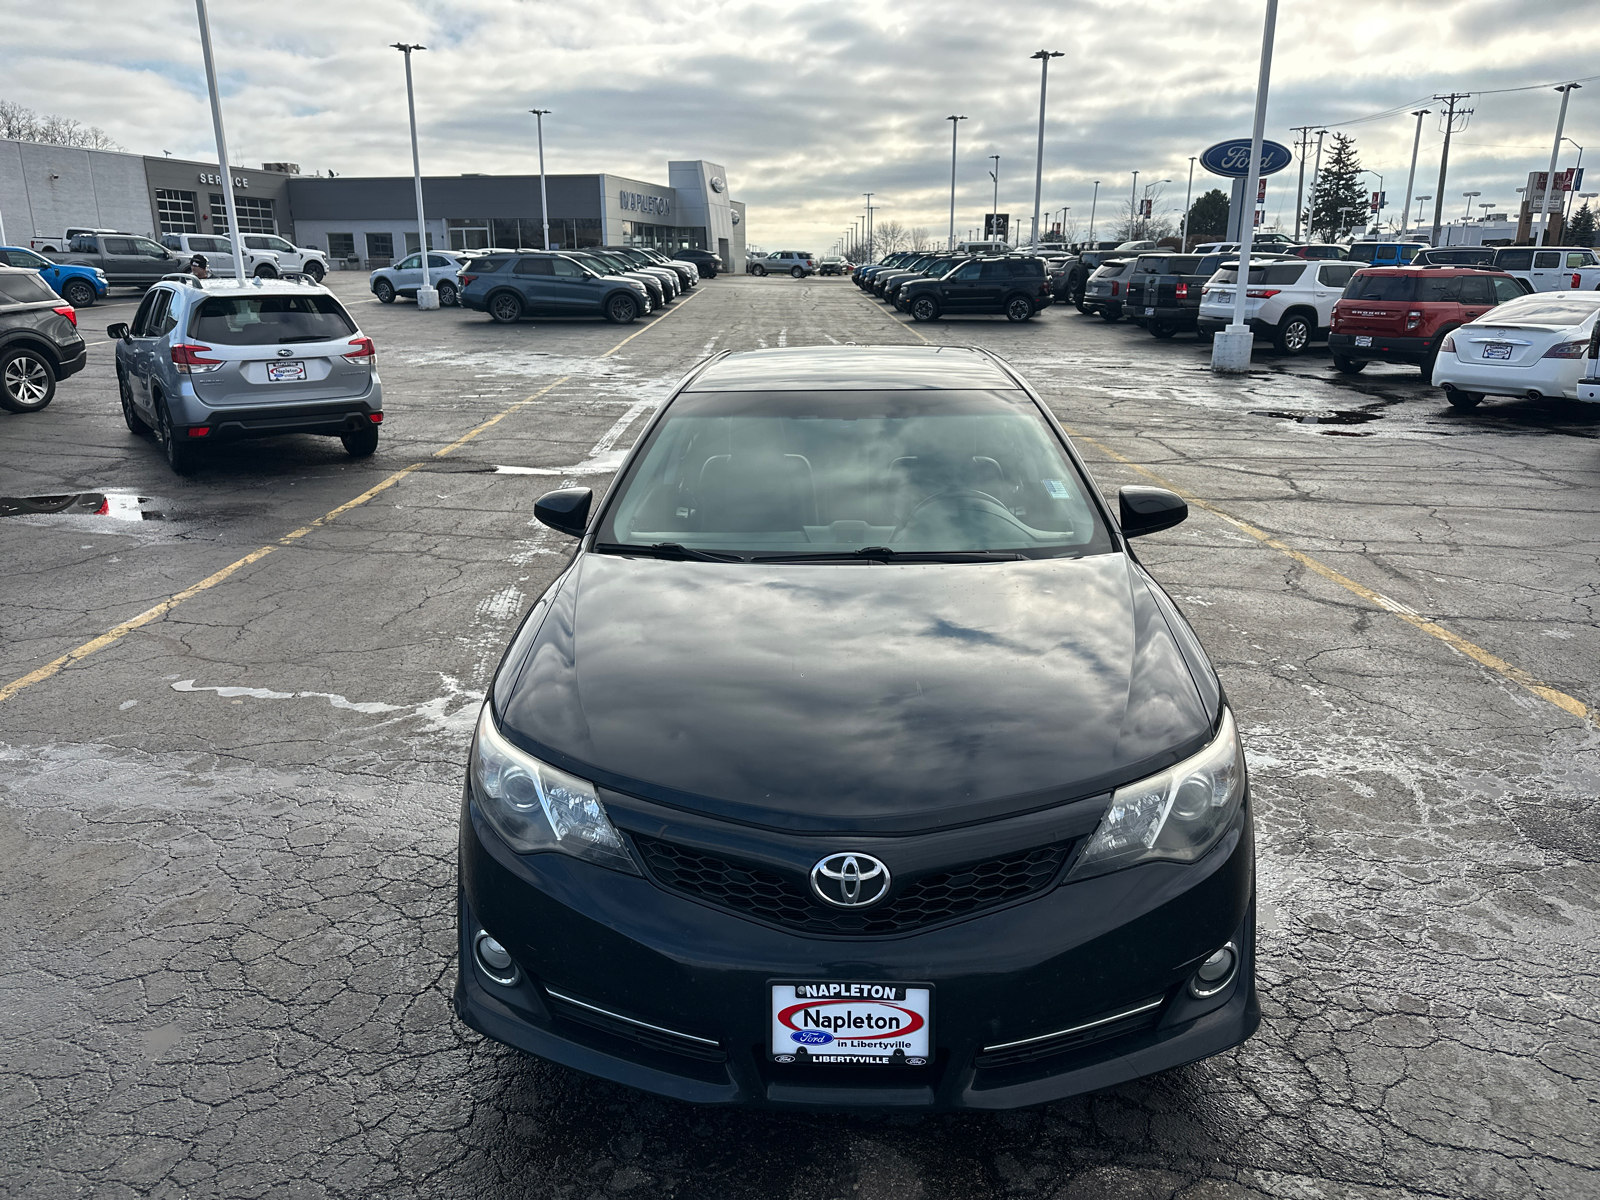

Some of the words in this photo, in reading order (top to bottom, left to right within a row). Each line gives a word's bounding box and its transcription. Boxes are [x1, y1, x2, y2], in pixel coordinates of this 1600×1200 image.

[1221, 146, 1274, 169] Fod
[200, 173, 248, 188] SERICE
[620, 190, 670, 216] NAPLETON
[805, 984, 896, 1000] NAPLETON
[803, 1009, 901, 1033] Napleton
[800, 1032, 825, 1043] Ford
[837, 1040, 847, 1048] in
[850, 1040, 912, 1050] Libertyville
[812, 1055, 890, 1064] LIBERTYVILLE
